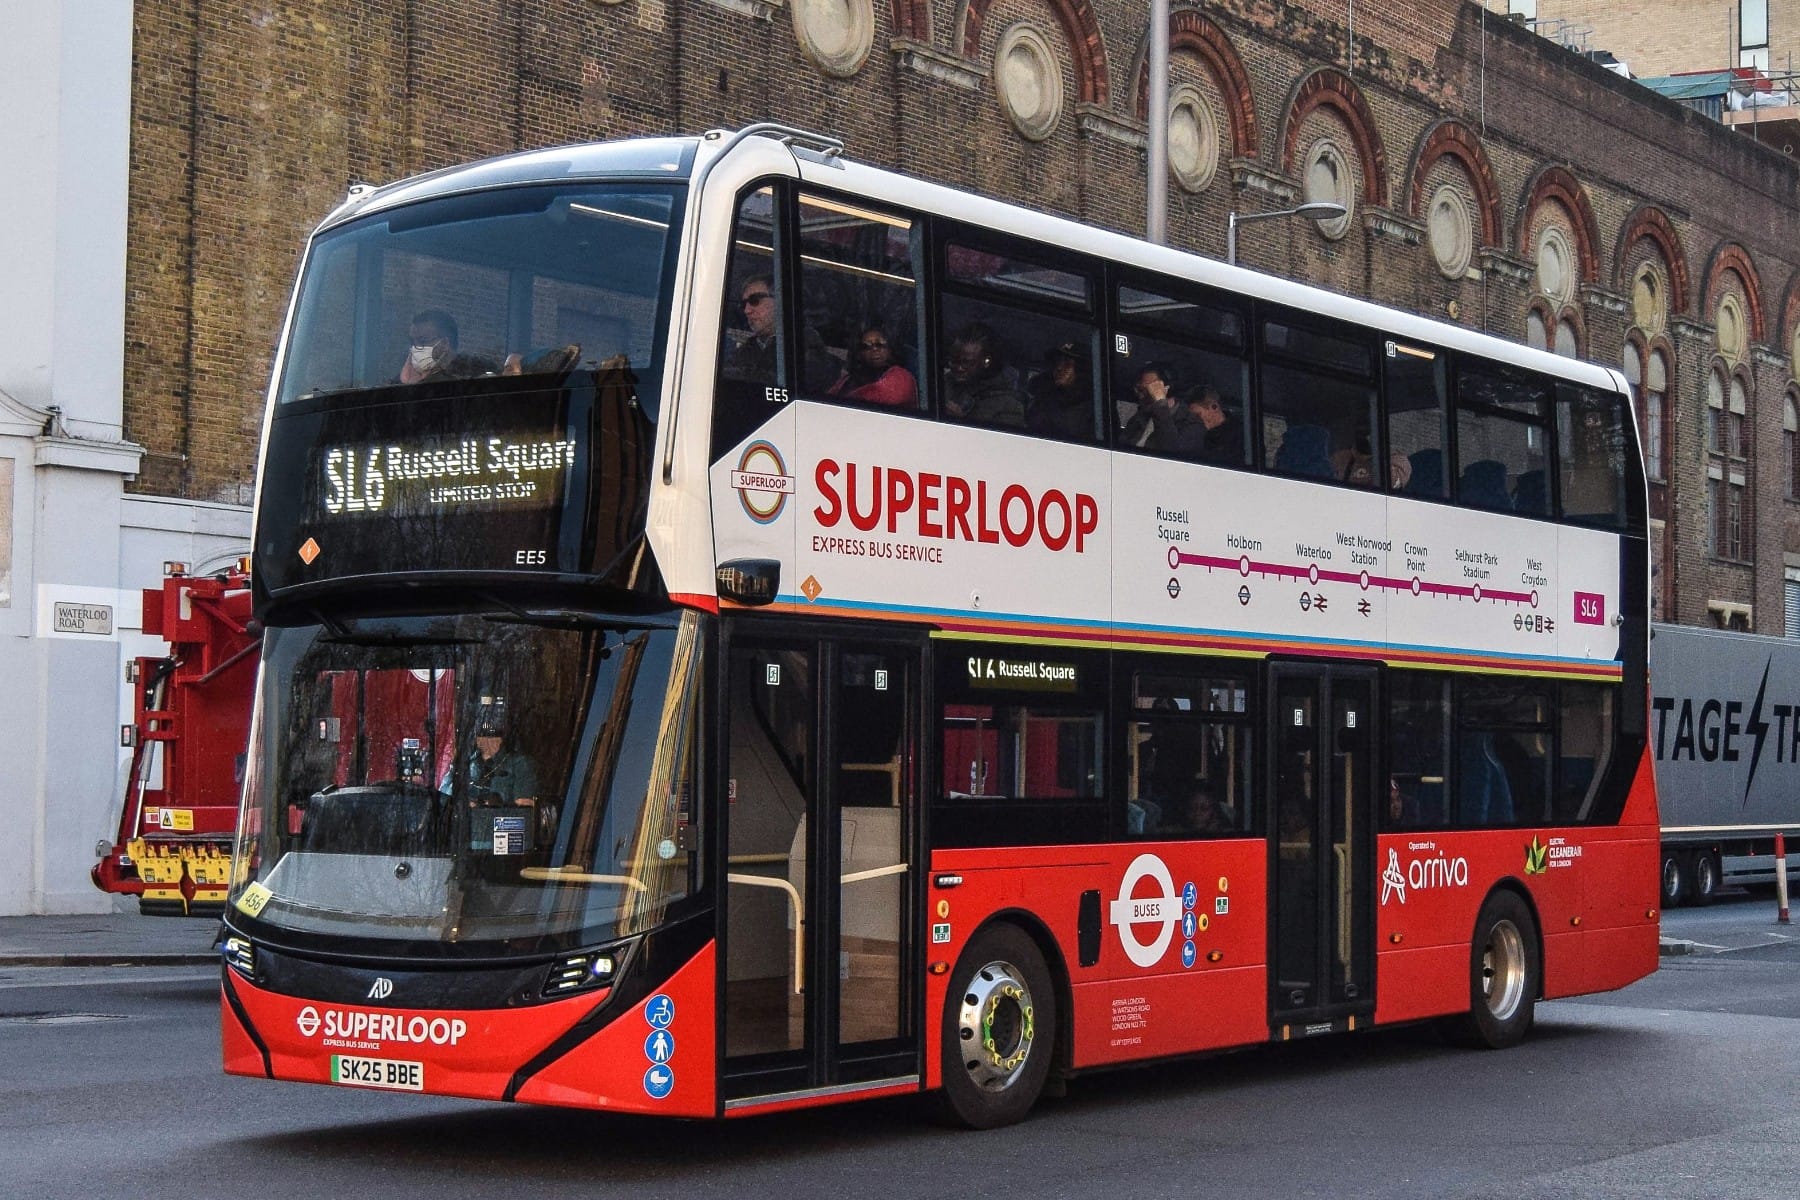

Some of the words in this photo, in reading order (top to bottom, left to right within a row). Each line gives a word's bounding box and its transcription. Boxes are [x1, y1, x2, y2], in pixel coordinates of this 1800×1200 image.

[766, 387, 789, 402] EE5
[388, 440, 480, 480] Russell
[326, 447, 385, 514] SL6
[740, 475, 787, 489] SUPERLOOP
[430, 484, 492, 504] LIMITED
[496, 481, 537, 499] STOP
[813, 458, 1099, 553] SUPERLOOP
[1156, 506, 1190, 524] Russell
[1158, 525, 1190, 543] Square
[1227, 534, 1262, 551] Holborn
[1336, 532, 1356, 548] West
[1357, 535, 1392, 552] Norwood
[515, 550, 547, 564] EE5
[813, 535, 866, 556] EXPRESS
[869, 541, 893, 558] BUS
[896, 543, 943, 563] SERVICE
[1296, 543, 1332, 560] Waterloo
[1404, 542, 1428, 557] Crown
[1455, 548, 1483, 564] Selhurst
[1484, 553, 1498, 566] Park
[1351, 551, 1378, 566] Station
[1407, 558, 1426, 573] Point
[1526, 558, 1543, 572] West
[1463, 565, 1491, 580] Stadium
[1521, 572, 1548, 587] Croydon
[59, 607, 108, 621] WATERLOO
[1581, 599, 1598, 618] SL6
[59, 618, 85, 629] ROAD
[999, 660, 1038, 678] Russell
[1040, 662, 1075, 681] Square
[1408, 841, 1430, 852] Operated
[1429, 840, 1436, 851] by
[1408, 850, 1468, 890] arriva
[245, 892, 265, 911] 456
[1134, 903, 1161, 918] BUSES
[324, 1010, 467, 1045] SUPERLOOP
[323, 1038, 346, 1047] EXPRESS
[346, 1040, 357, 1048] BUS
[357, 1041, 381, 1050] SERVICE
[341, 1058, 382, 1082] SK25
[386, 1062, 419, 1086] BBE
